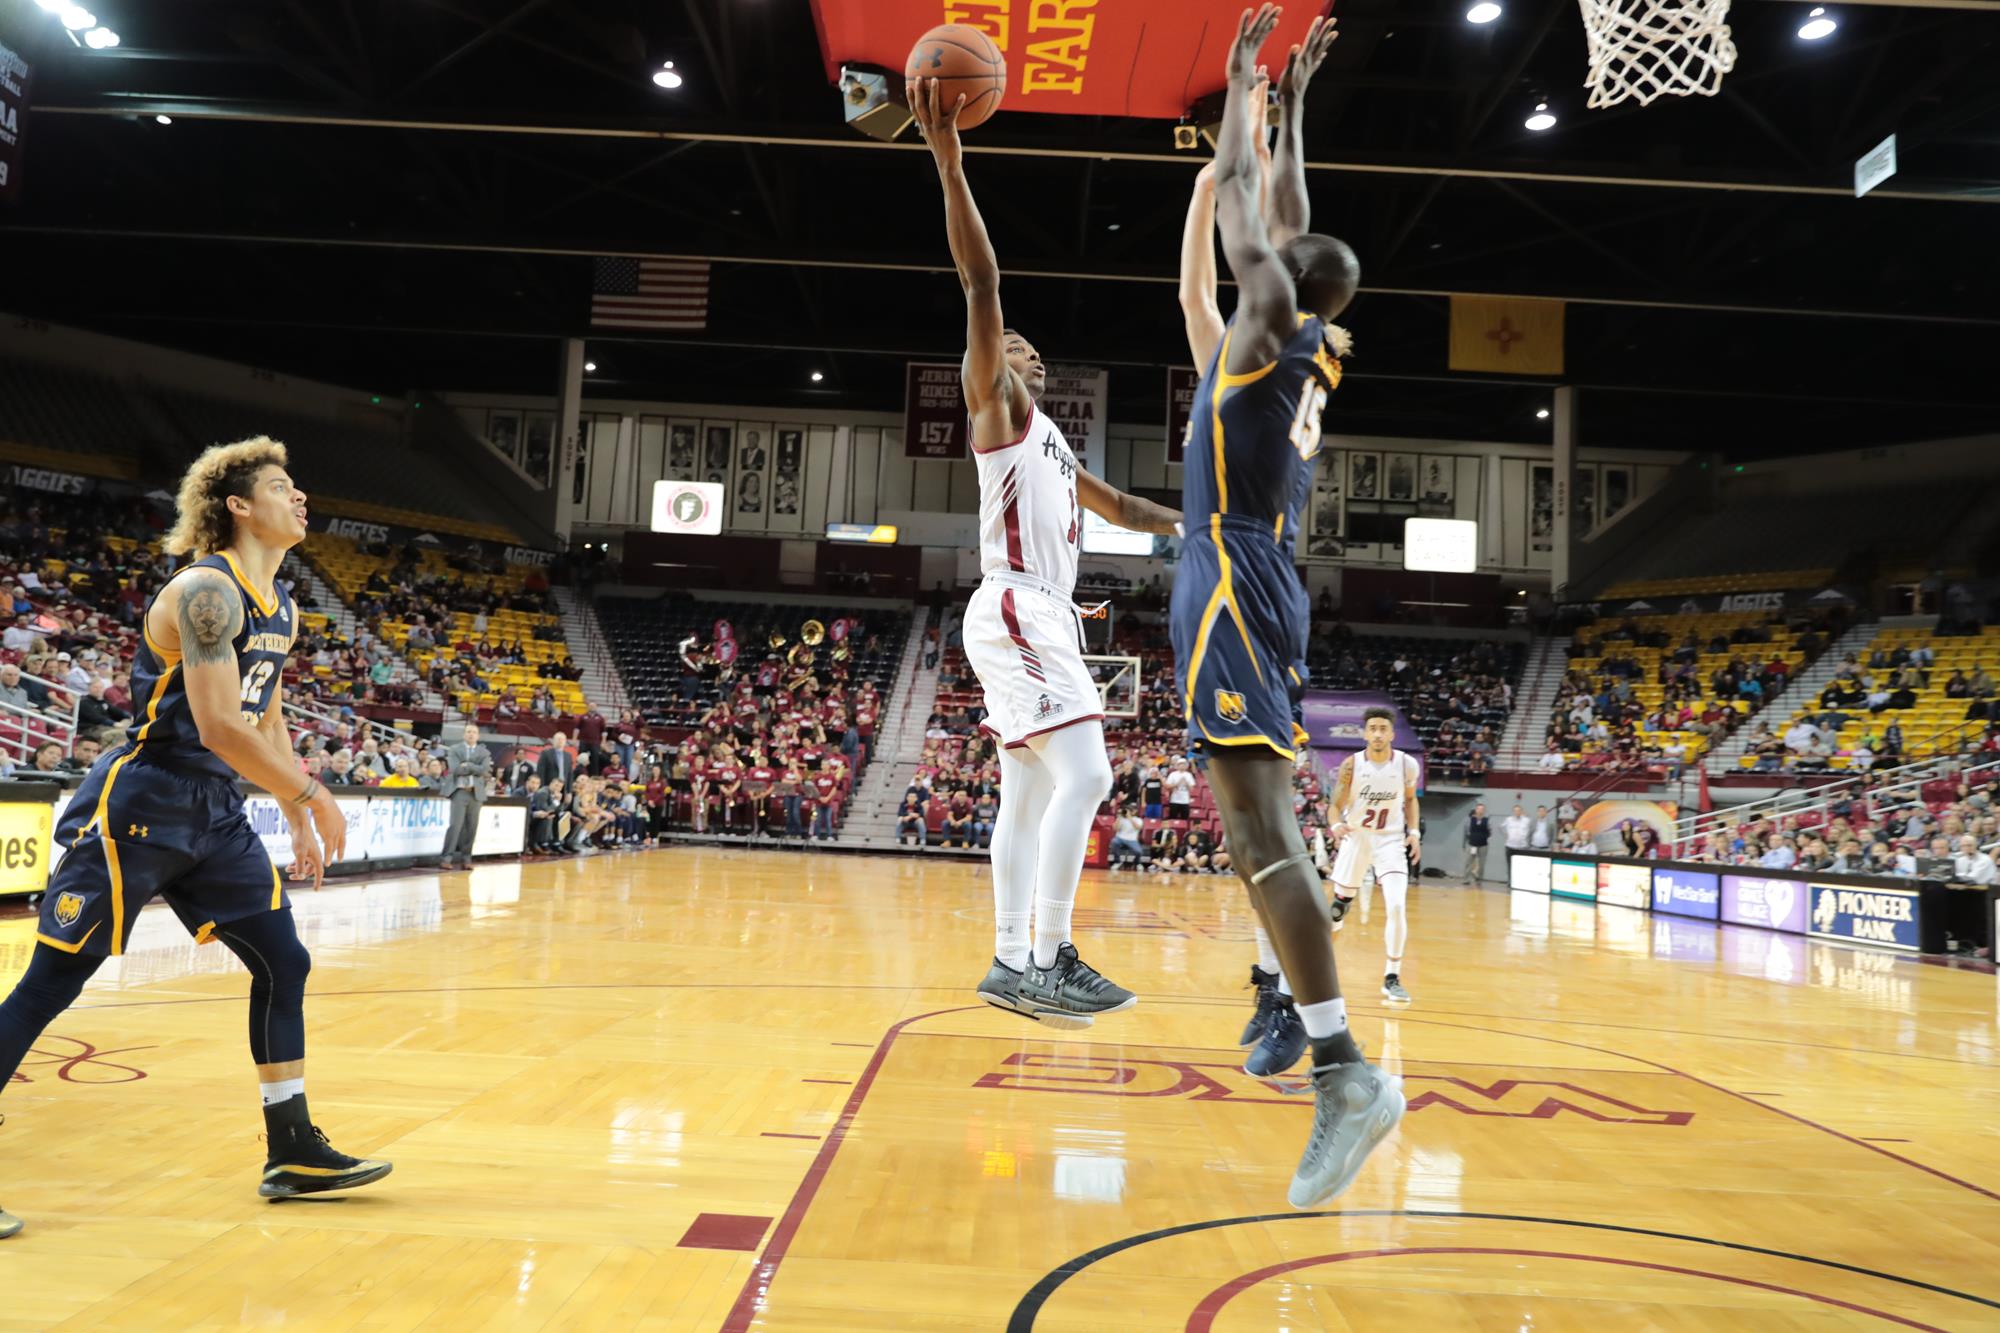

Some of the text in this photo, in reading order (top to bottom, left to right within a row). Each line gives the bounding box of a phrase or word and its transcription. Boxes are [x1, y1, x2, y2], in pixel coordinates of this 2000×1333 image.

[917, 370, 961, 384] JERRY
[919, 421, 955, 444] 157
[1719, 592, 1784, 613] AGGIES
[1359, 785, 1397, 806] Aggies
[391, 798, 444, 828] FYZICAL
[1362, 808, 1390, 830] 20
[1838, 891, 1914, 922] PIONEER
[1852, 917, 1897, 942] BANK
